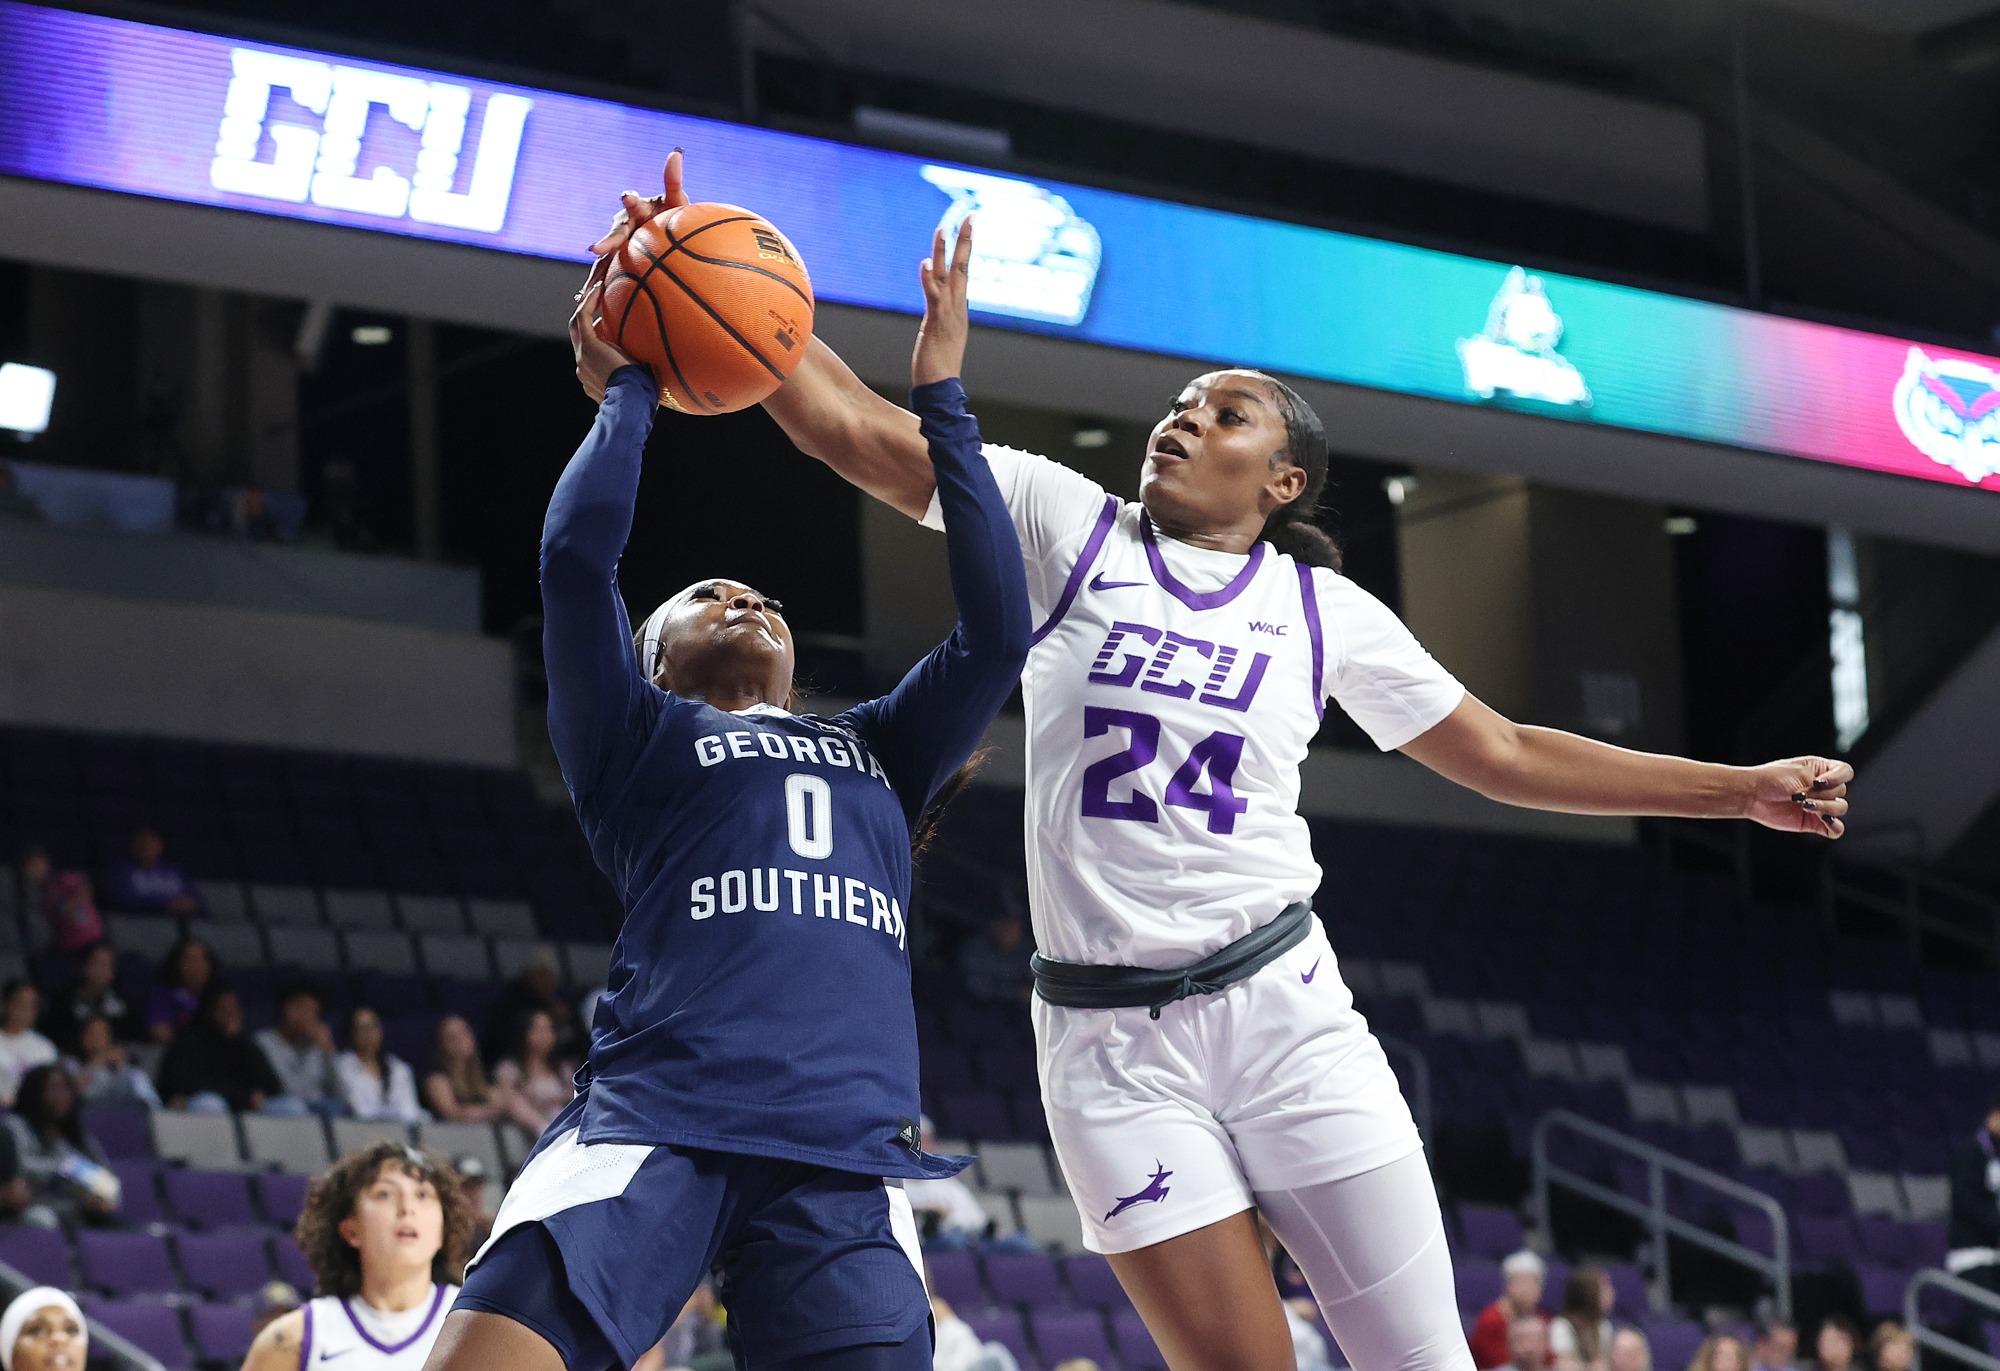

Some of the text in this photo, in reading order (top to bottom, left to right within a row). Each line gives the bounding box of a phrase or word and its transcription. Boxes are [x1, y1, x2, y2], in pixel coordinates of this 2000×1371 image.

[210, 47, 533, 233] GCU
[1088, 621, 1272, 712] GCU
[1248, 621, 1288, 636] WAC
[694, 731, 892, 790] GEORGIA
[1081, 705, 1248, 835] 24
[784, 773, 833, 860] 0
